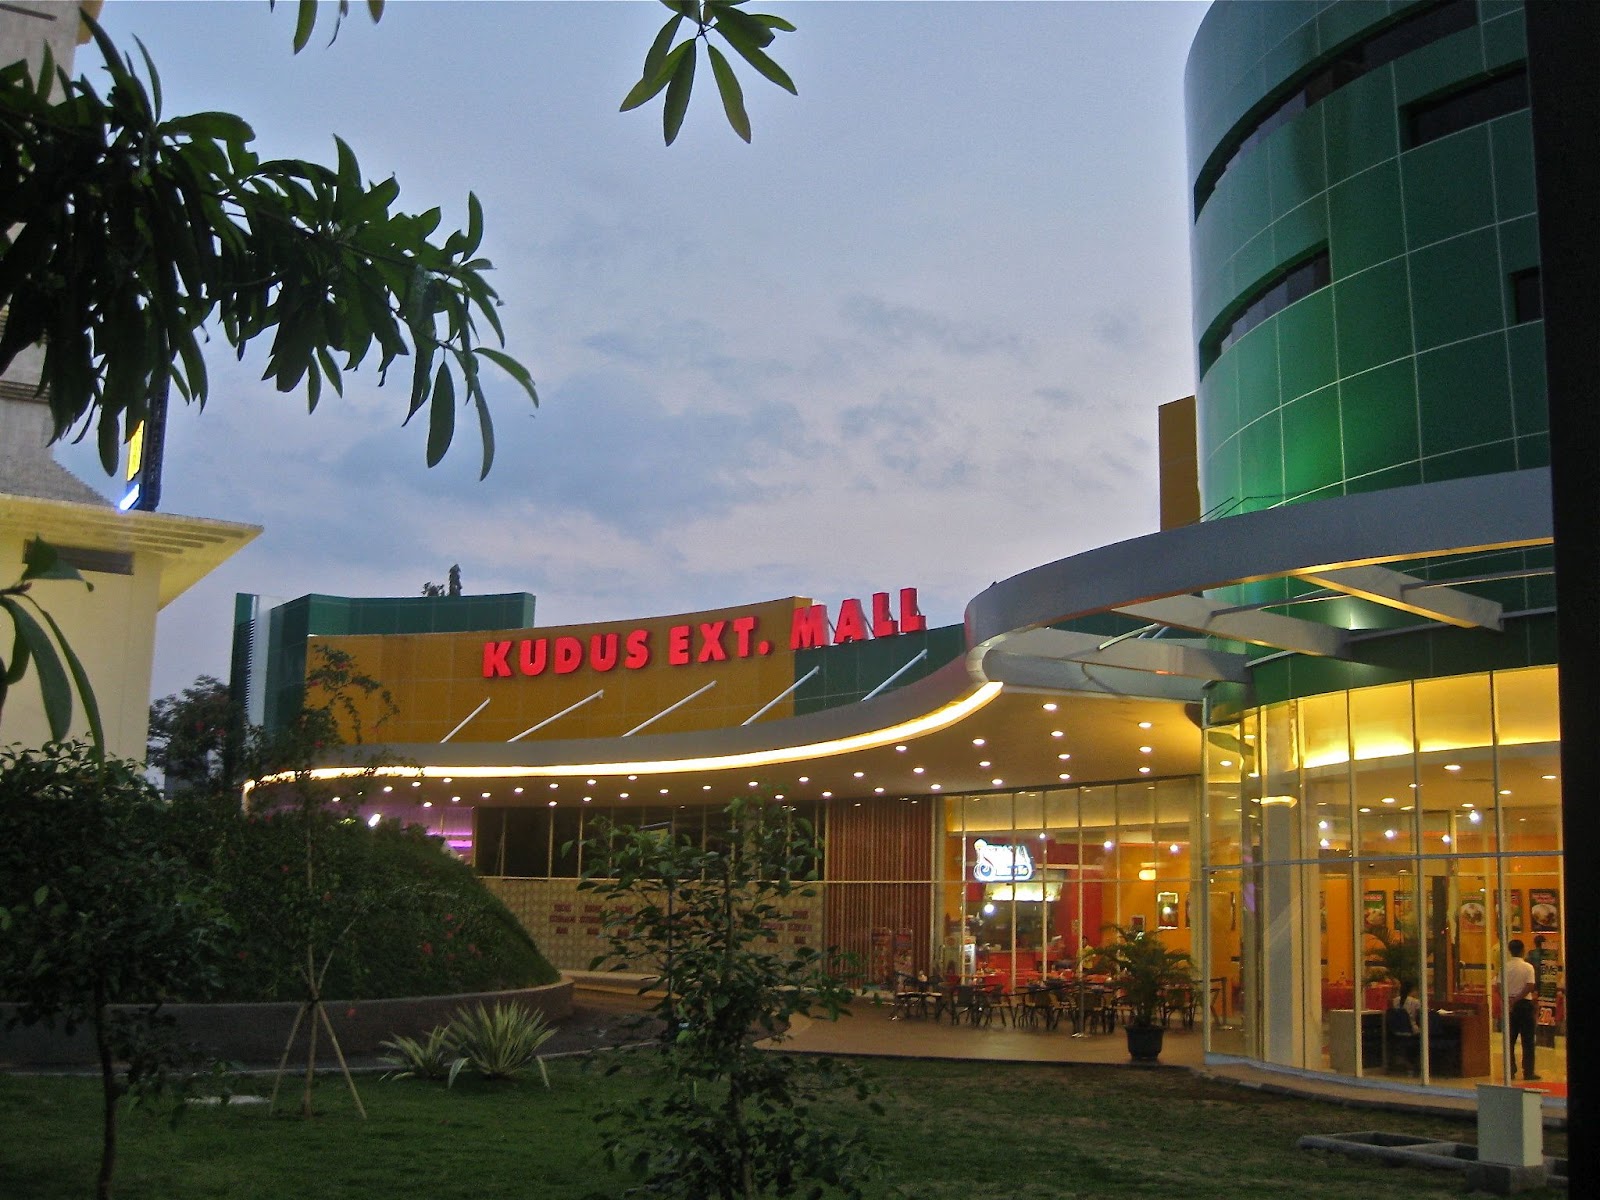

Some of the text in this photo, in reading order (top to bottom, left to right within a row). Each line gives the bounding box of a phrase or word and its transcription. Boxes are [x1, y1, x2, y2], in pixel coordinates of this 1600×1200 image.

[482, 588, 927, 678] KUDUS EXT. MALL
